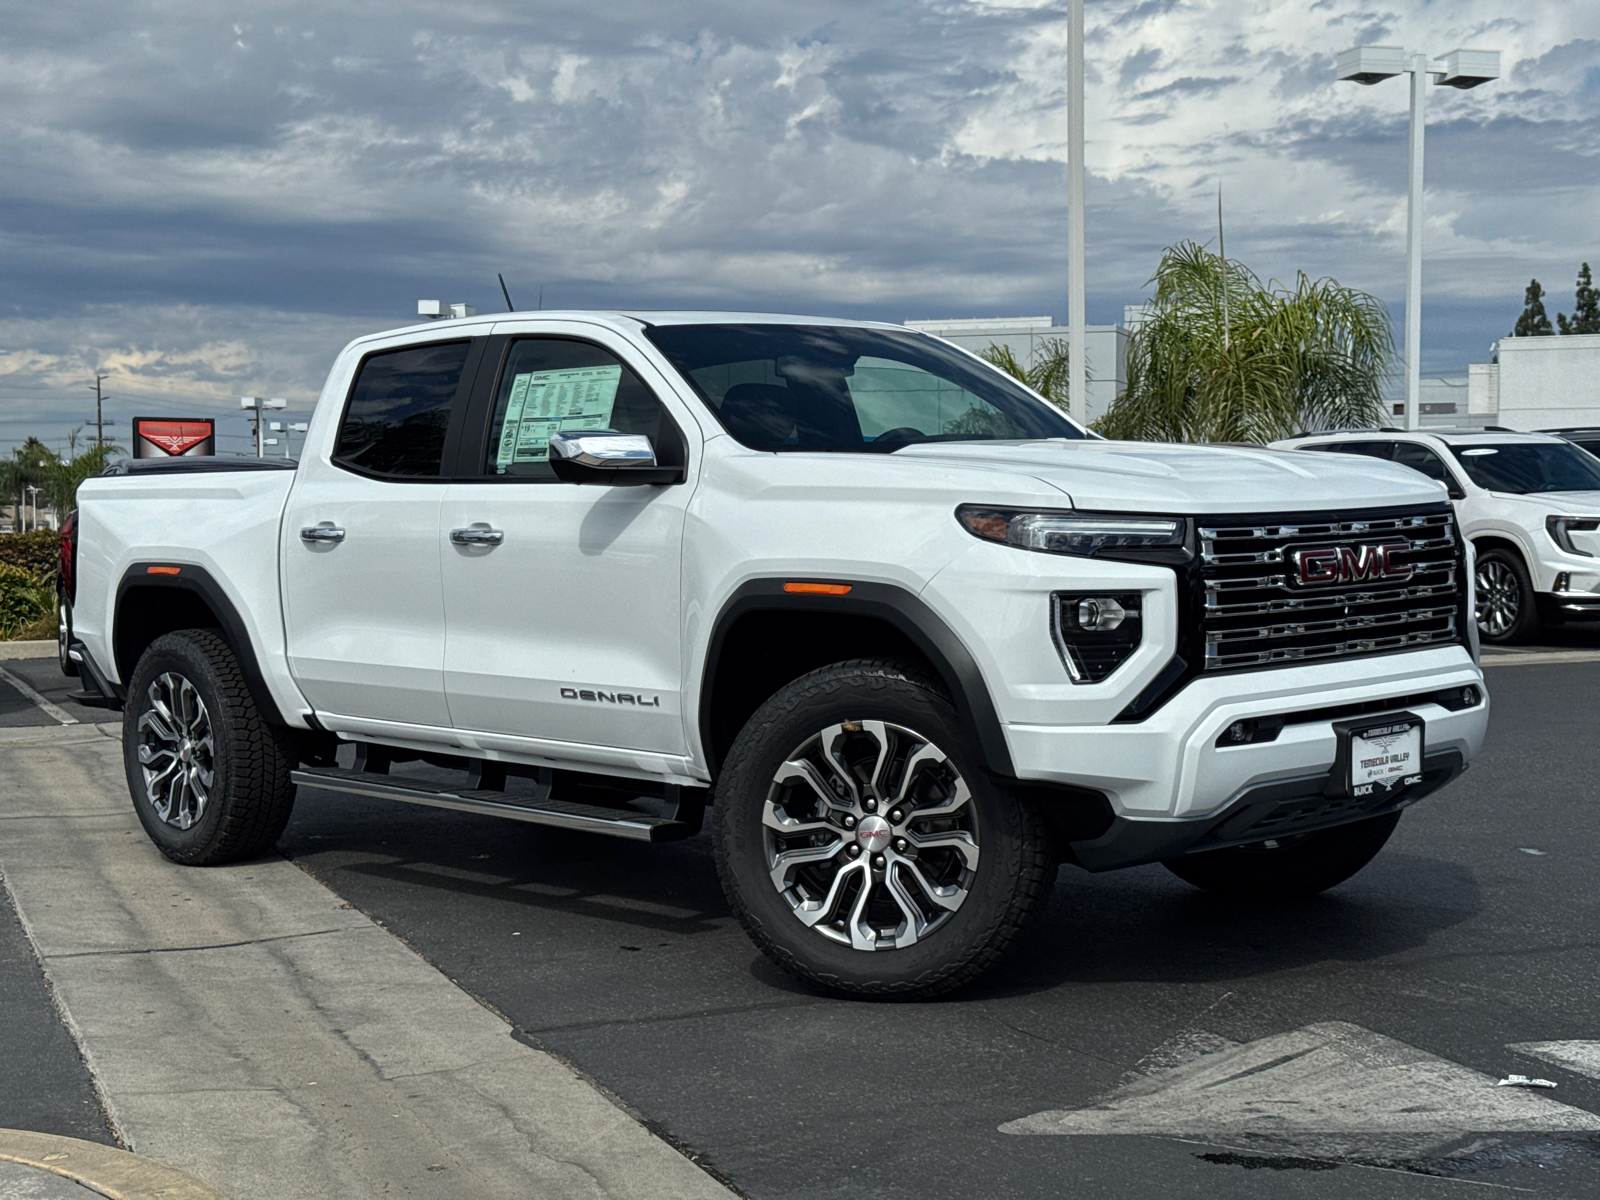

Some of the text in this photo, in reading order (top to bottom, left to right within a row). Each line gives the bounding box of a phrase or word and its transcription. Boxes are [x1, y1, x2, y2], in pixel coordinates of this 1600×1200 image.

[1295, 544, 1413, 585] GMC
[560, 688, 660, 707] DENALI
[1360, 752, 1410, 769] TEMECULA VALLEY
[1388, 765, 1403, 773] GMC
[1404, 775, 1422, 786] GMC
[1353, 784, 1373, 797] BUICK
[860, 829, 889, 839] GMC
